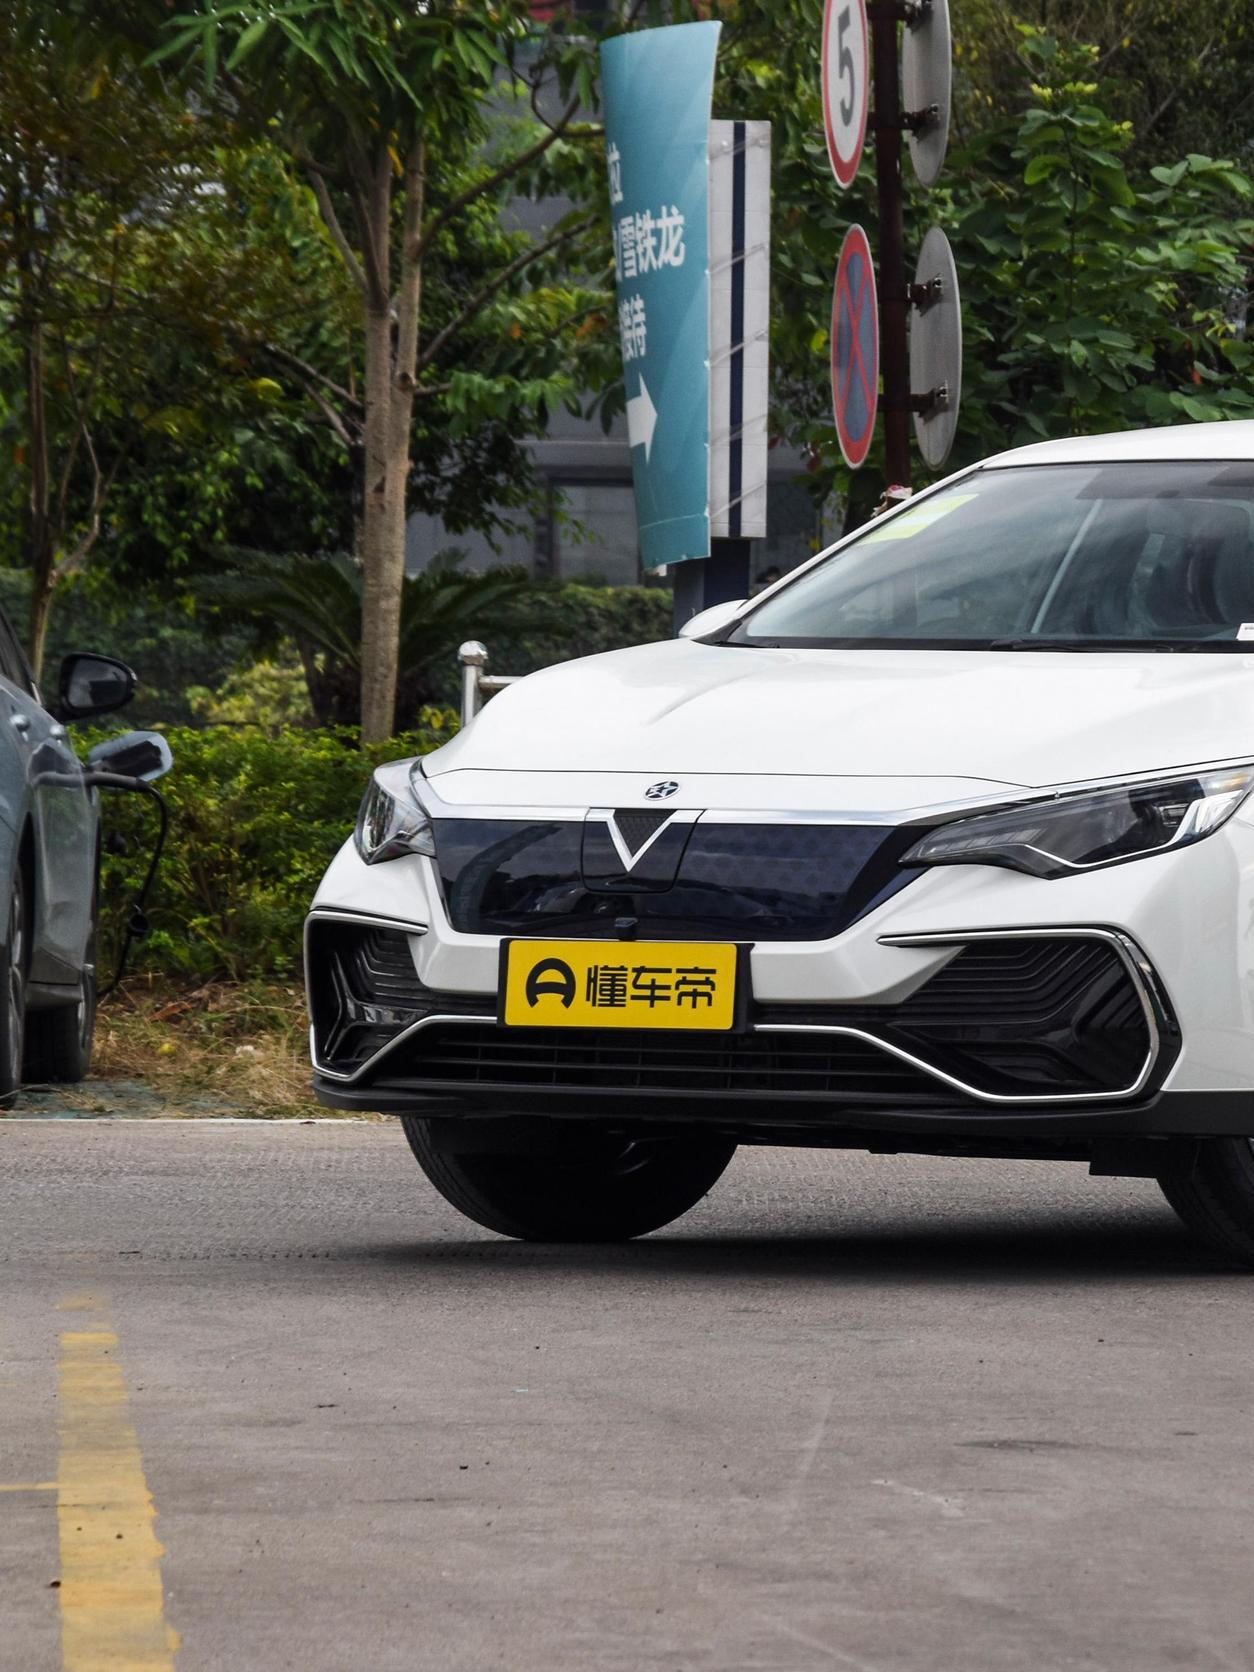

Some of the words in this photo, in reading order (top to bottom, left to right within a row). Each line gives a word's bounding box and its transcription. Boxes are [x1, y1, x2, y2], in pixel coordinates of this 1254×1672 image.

[836, 5, 857, 128] 5
[585, 964, 717, 1009] 懂车帝
